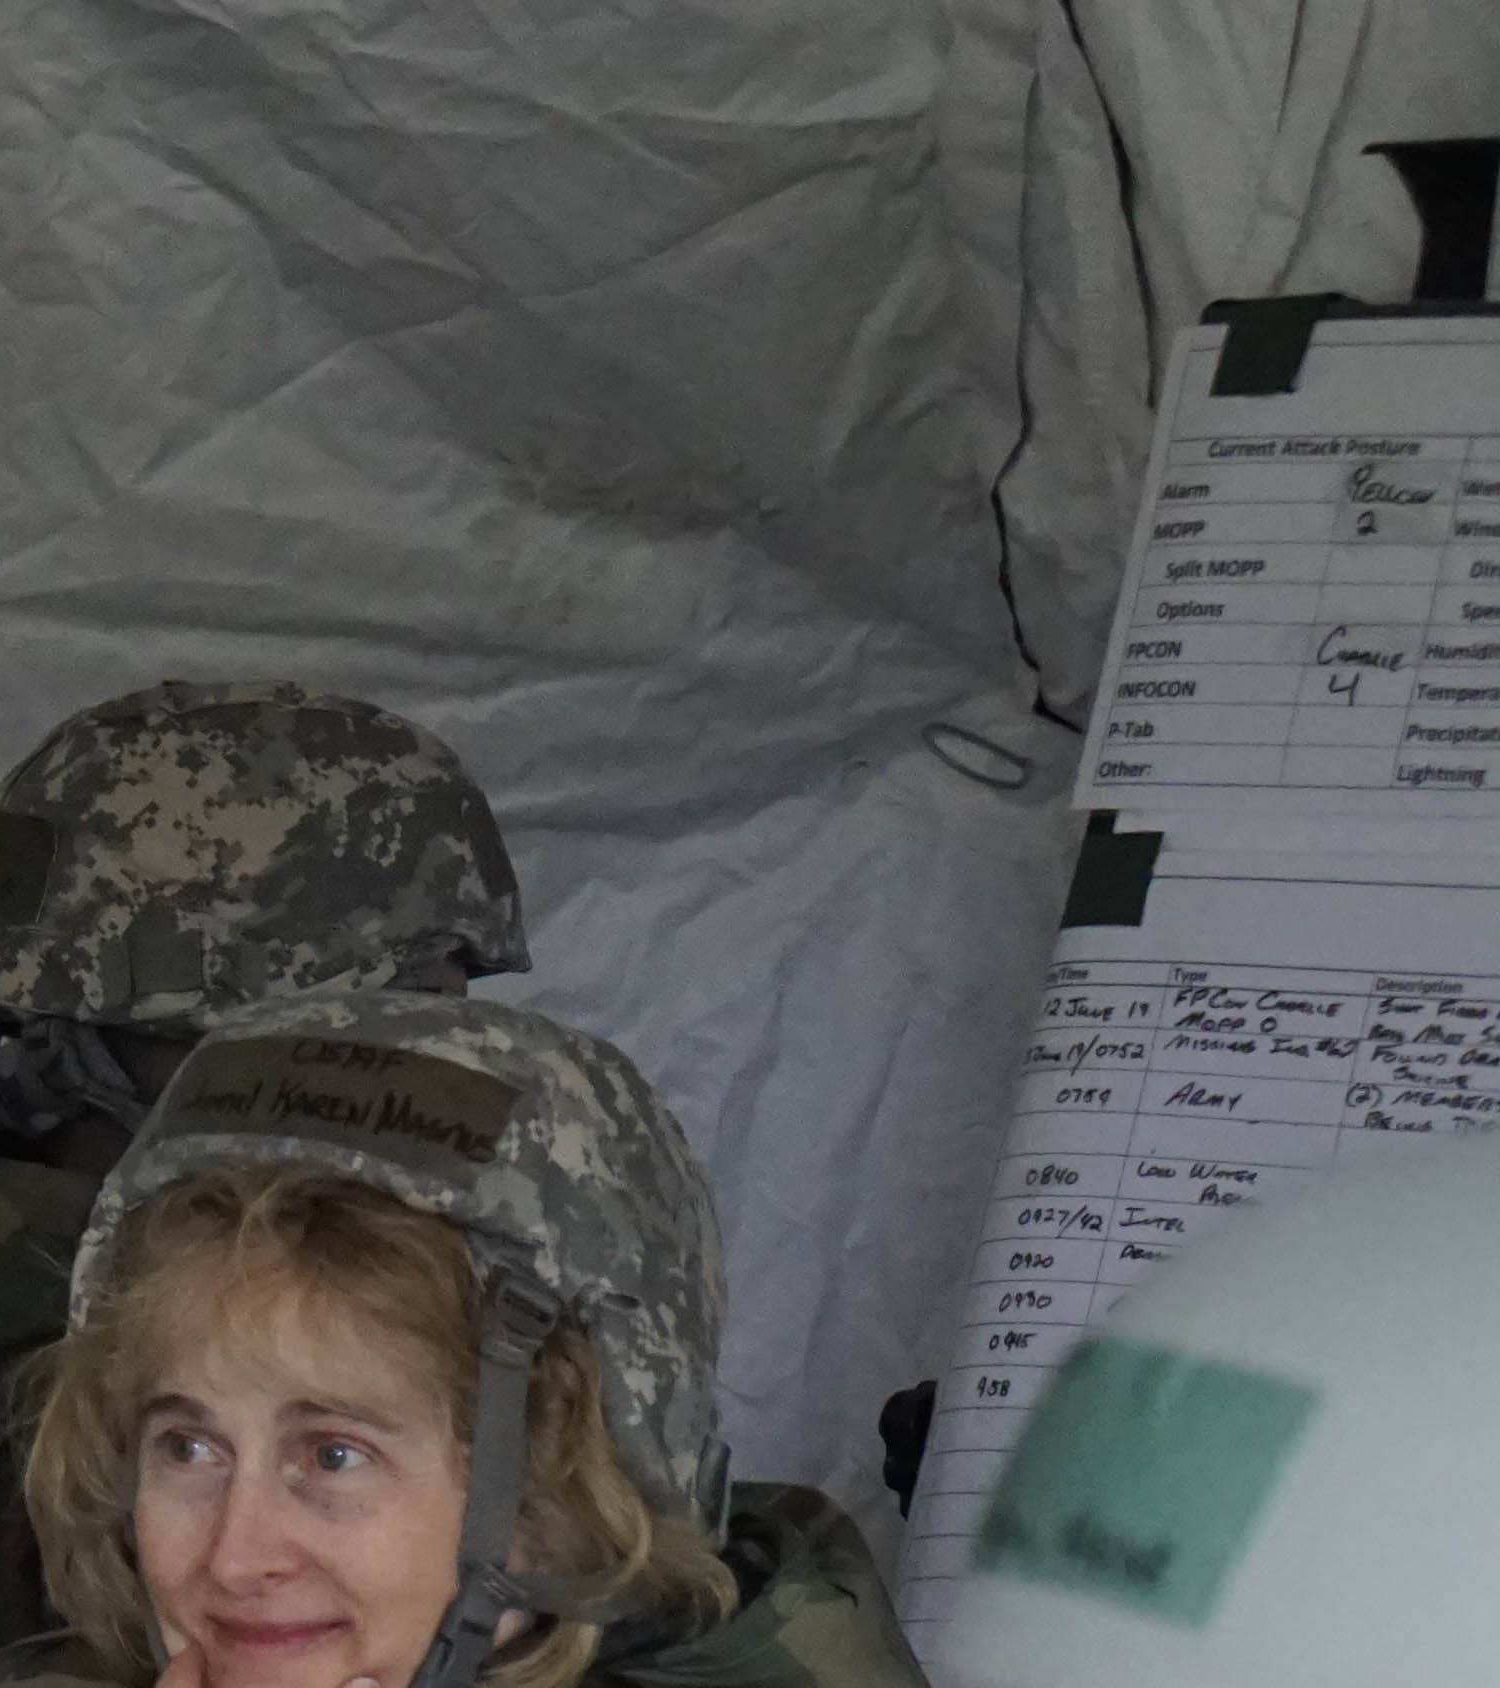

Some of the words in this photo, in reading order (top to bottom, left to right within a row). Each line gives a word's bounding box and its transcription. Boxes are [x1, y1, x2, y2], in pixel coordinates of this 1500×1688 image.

[1208, 440, 1275, 458] Current
[1282, 440, 1341, 457] Attack
[1346, 439, 1421, 456] Posture
[1162, 483, 1211, 500] Alarm
[1153, 519, 1206, 541] MOPP
[1357, 510, 1378, 536] 2
[1165, 561, 1203, 580] Split
[1207, 559, 1266, 578] MOPP
[1156, 602, 1226, 620] Options
[1127, 641, 1183, 660] FPCON
[1117, 680, 1197, 699] INFOCON
[1328, 672, 1360, 706] 4
[1099, 761, 1152, 780] Other:
[1396, 764, 1488, 789] Lightning
[1174, 968, 1208, 983] Type
[1376, 977, 1464, 995] Description
